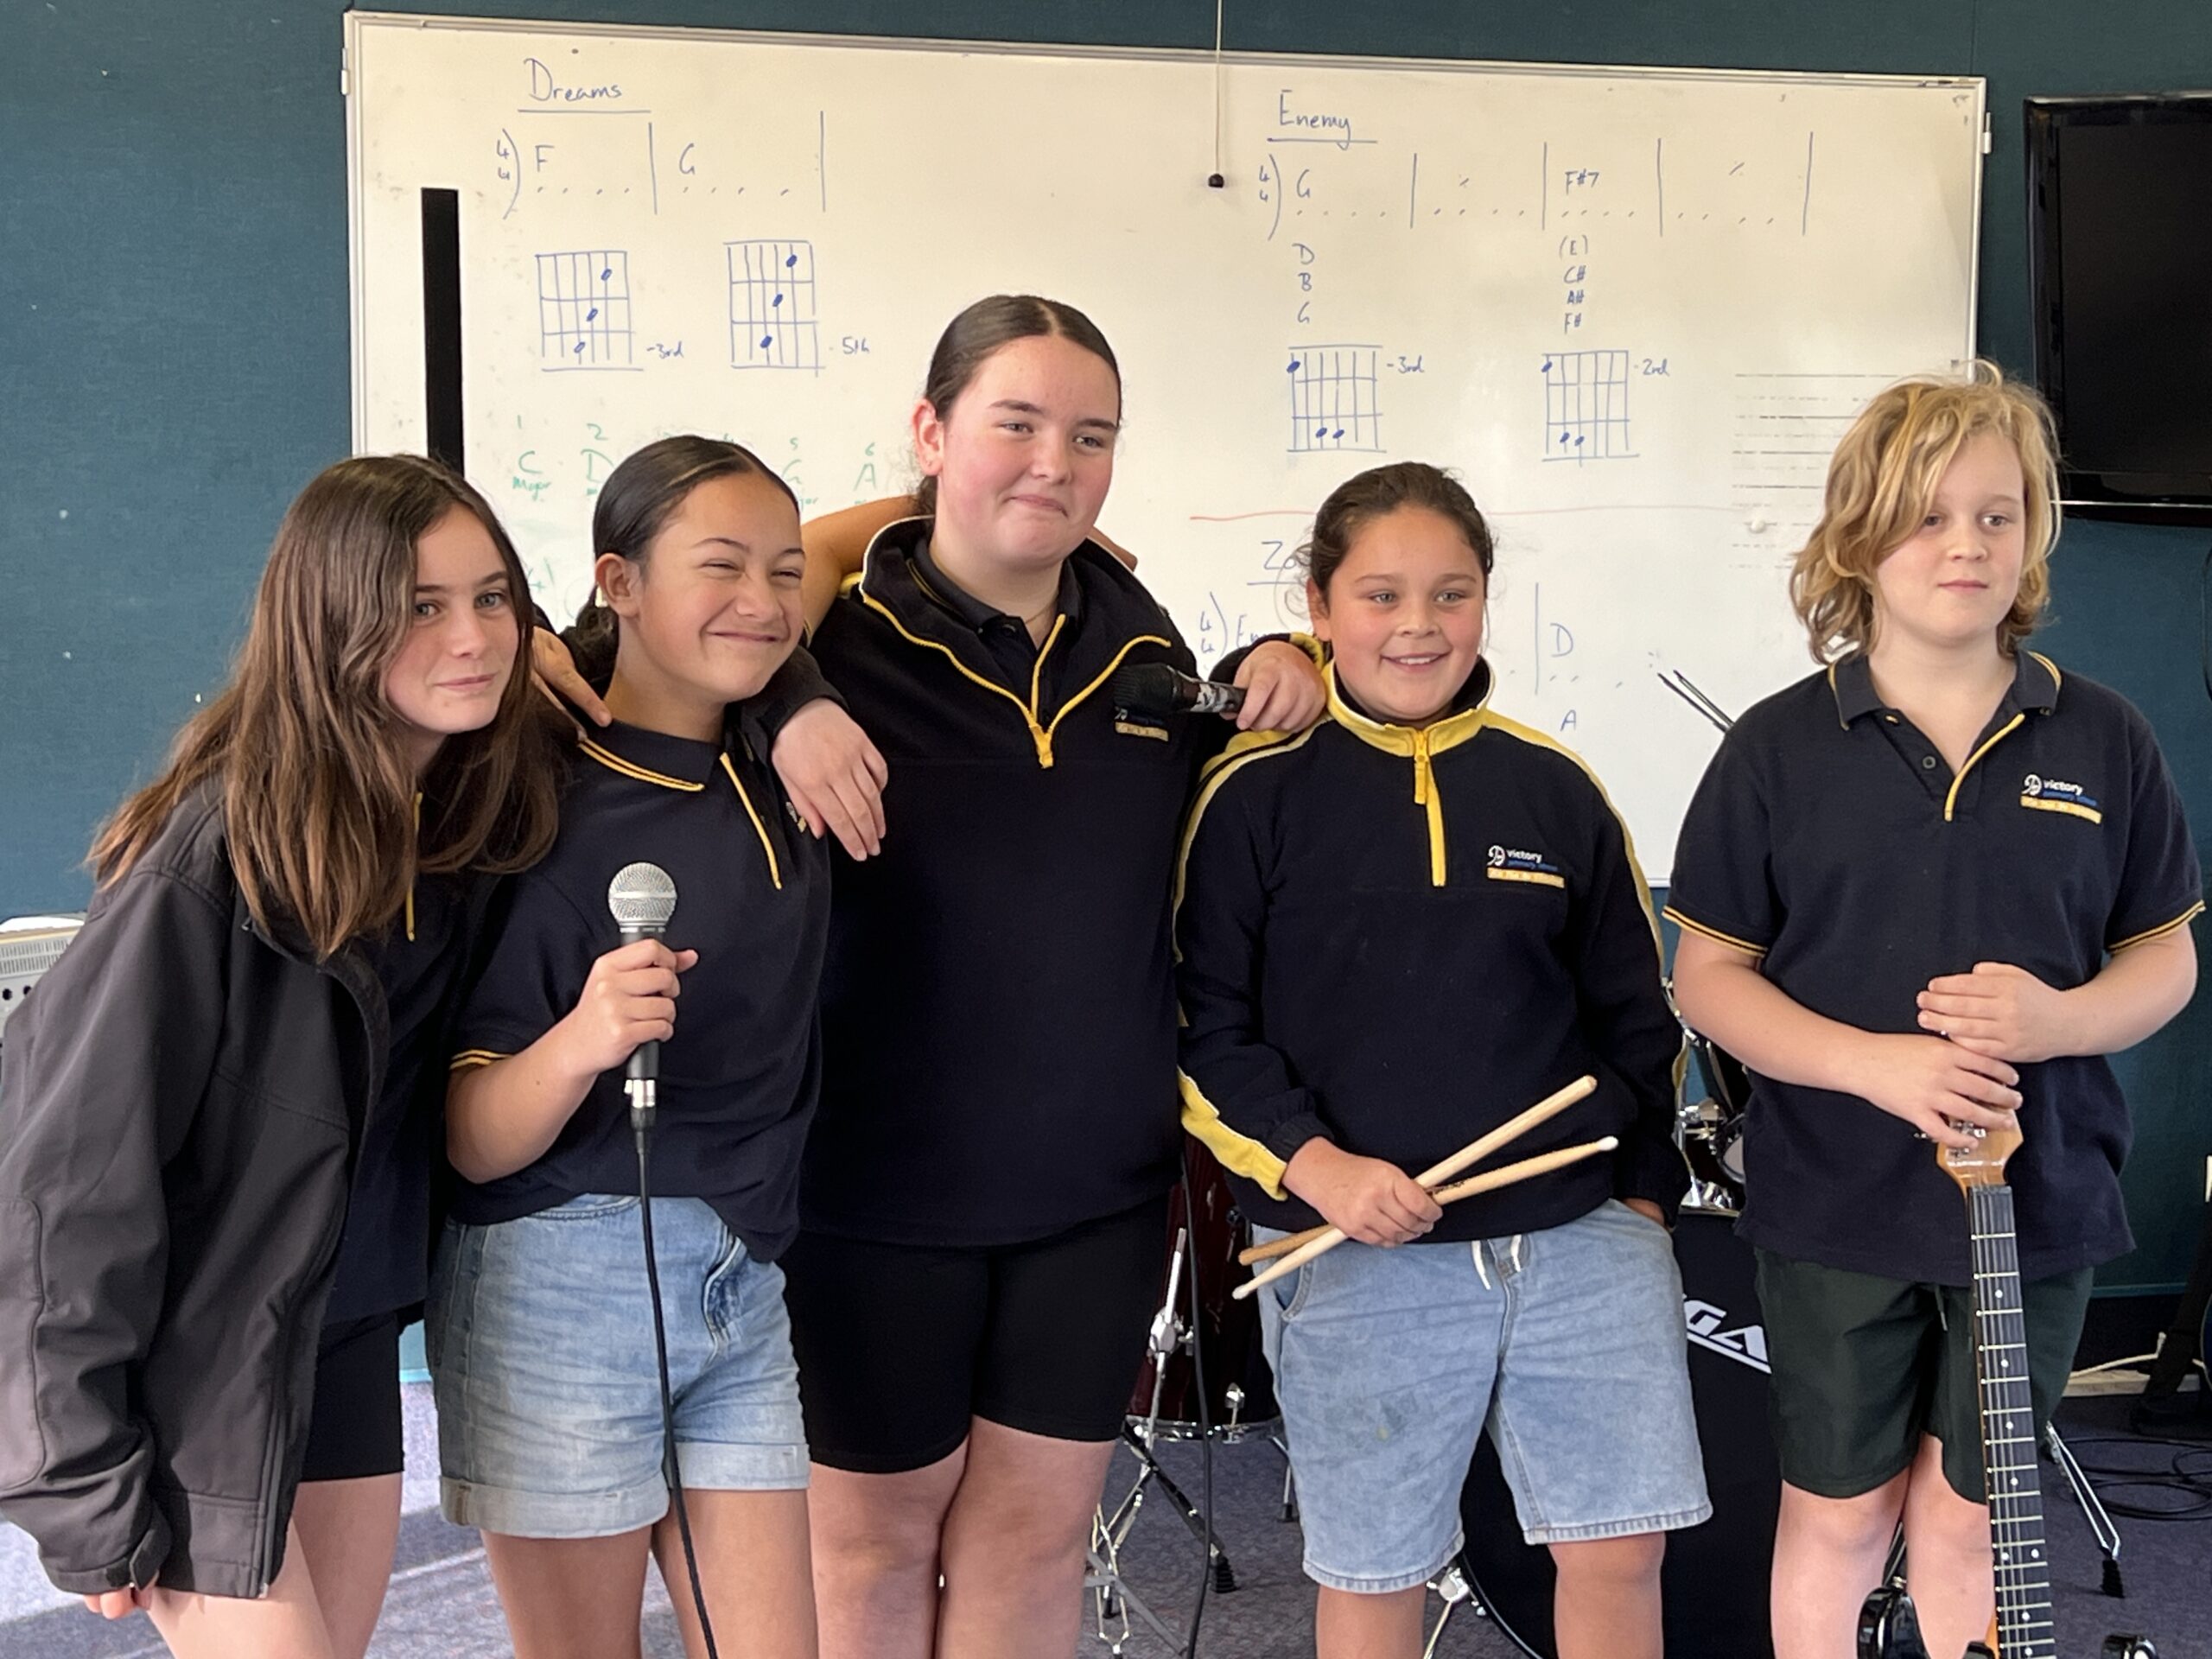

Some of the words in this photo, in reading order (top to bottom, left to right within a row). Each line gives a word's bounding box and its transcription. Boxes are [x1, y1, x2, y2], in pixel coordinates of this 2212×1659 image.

[524, 58, 622, 101] Dreams
[1279, 89, 1351, 150] Enemy
[535, 145, 555, 173] F
[678, 143, 696, 175] G
[1296, 168, 1311, 198] G
[1565, 168, 1599, 195] F#7
[1292, 243, 1315, 264] D
[1298, 272, 1313, 292] B
[1563, 265, 1586, 283] C#
[1297, 302, 1311, 324] G
[1564, 313, 1582, 334] F#
[587, 423, 608, 440] 2
[518, 450, 543, 474] C
[864, 442, 875, 456] 6
[854, 463, 876, 492] A
[1261, 540, 1298, 570] Zo
[1550, 623, 1573, 658] D
[1560, 709, 1577, 731] A
[1682, 1299, 1768, 1363] GA
